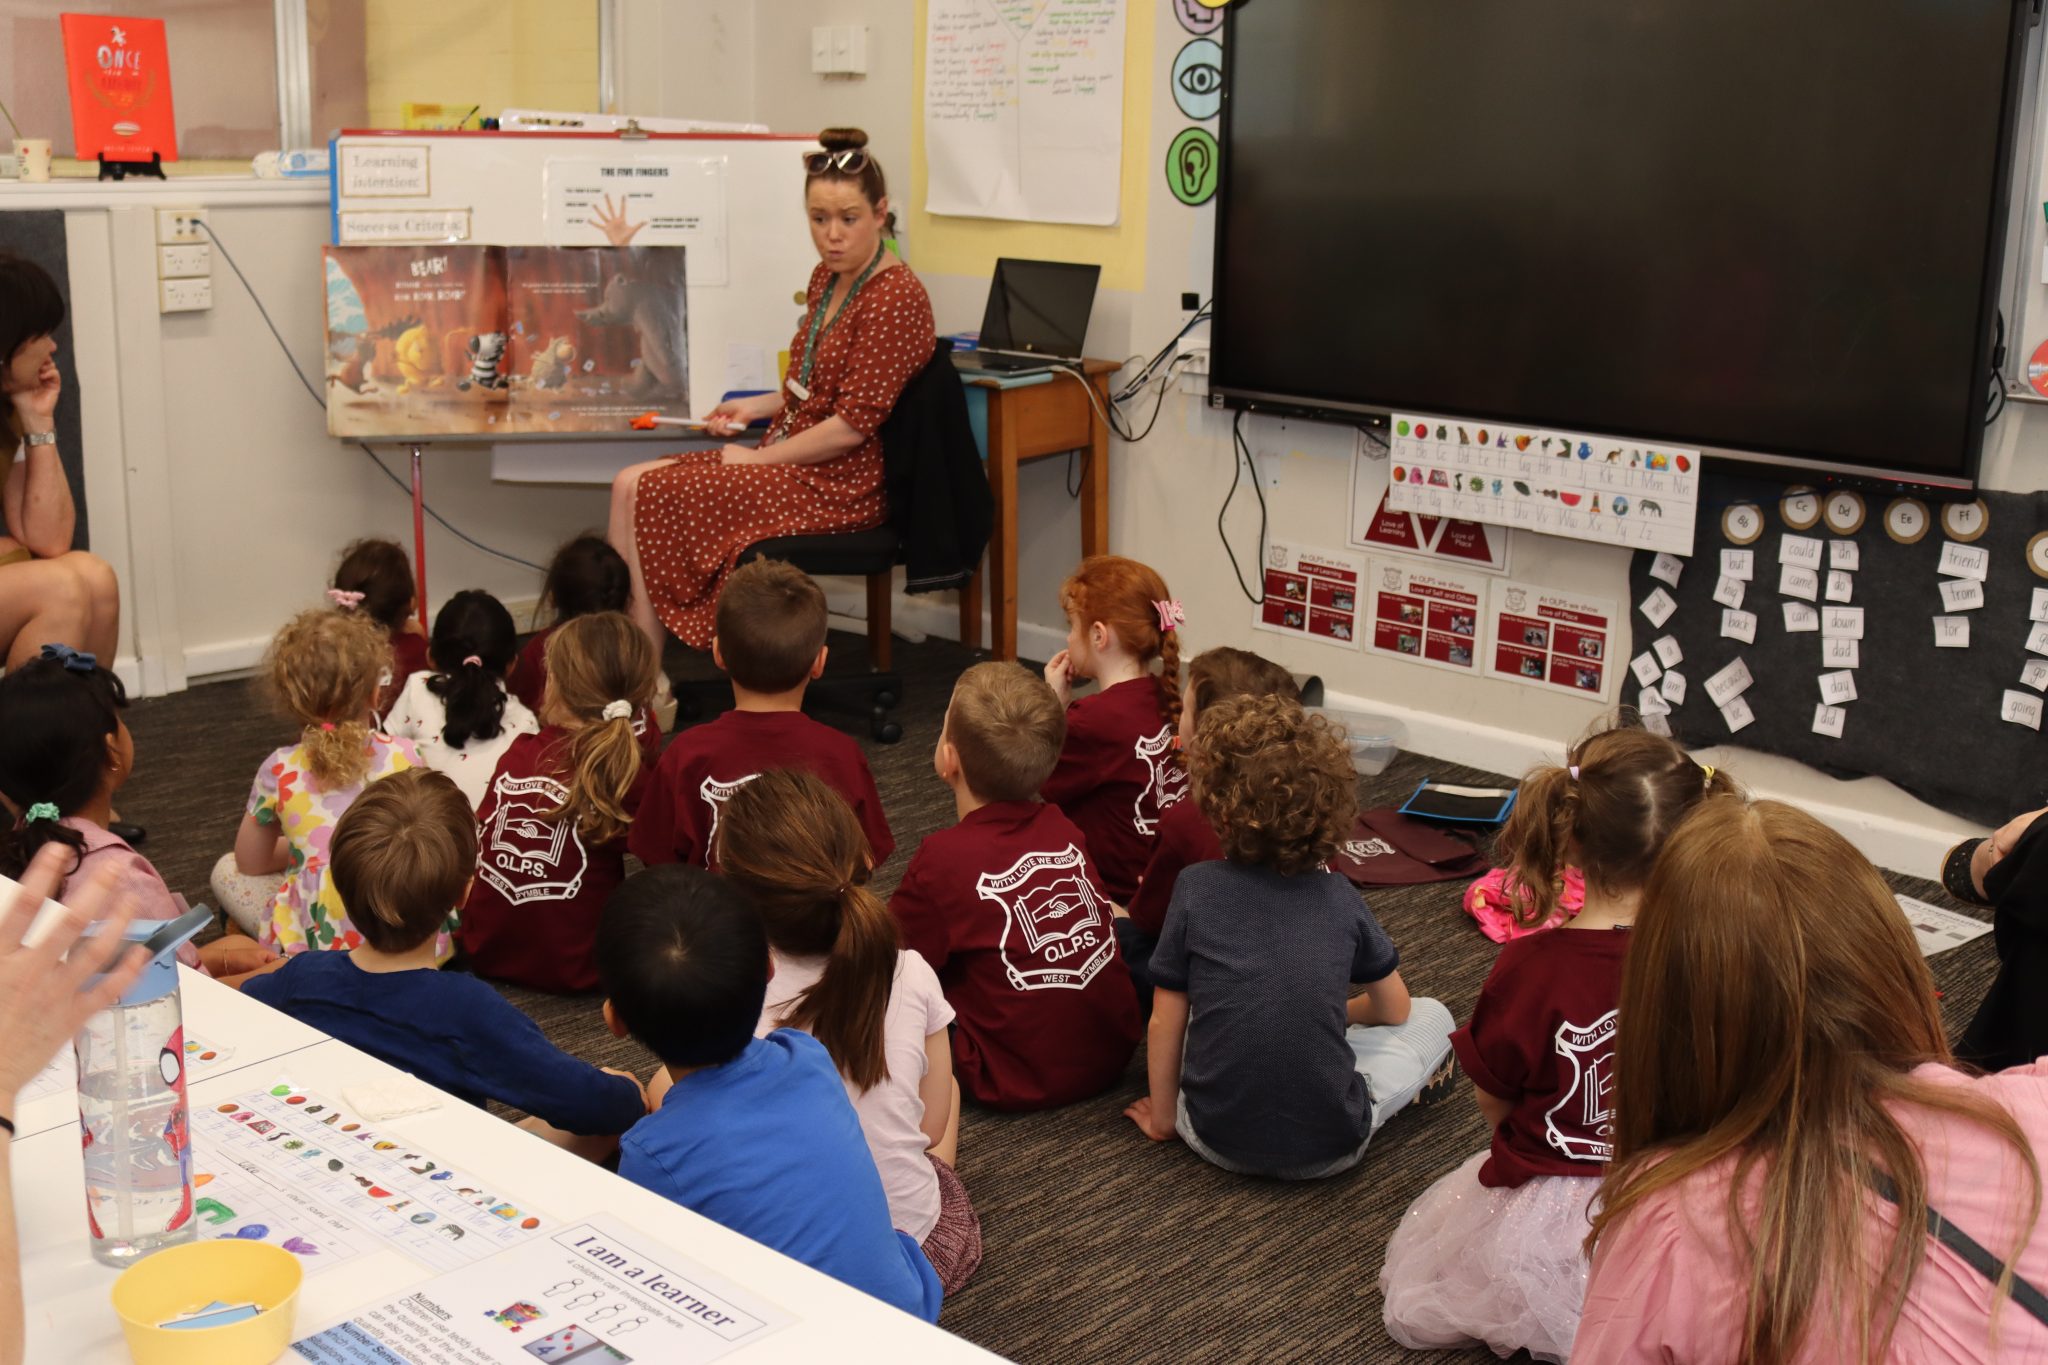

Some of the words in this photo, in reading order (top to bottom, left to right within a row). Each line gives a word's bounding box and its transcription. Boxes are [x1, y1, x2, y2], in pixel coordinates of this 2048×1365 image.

[97, 45, 142, 70] ONCE
[352, 155, 419, 169] Learning
[601, 168, 615, 177] THE
[617, 168, 634, 177] FIVE
[636, 168, 669, 177] FINGERS
[347, 220, 400, 232] Success
[1795, 500, 1808, 512] Cc
[1838, 504, 1851, 517] Dd
[1381, 519, 1397, 528] Love
[1397, 521, 1405, 530] of
[1737, 515, 1750, 528] Bb
[1900, 512, 1912, 525] Ee
[1958, 510, 1971, 522] Ff
[1379, 526, 1406, 538] Learning
[1788, 539, 1816, 559] could
[1949, 545, 1983, 569] friend
[1728, 551, 1745, 570] but
[1299, 564, 1313, 572] Love
[1319, 567, 1343, 579] Learning
[1788, 574, 1813, 590] came
[1410, 585, 1425, 594] Love
[1425, 587, 1432, 595] of
[1432, 588, 1443, 597] Self
[1444, 591, 1456, 600] and
[1456, 592, 1476, 604] Others
[1950, 583, 1977, 602] from
[1539, 607, 1553, 616] Love
[1553, 609, 1561, 618] of
[1561, 611, 1579, 621] Place
[1831, 609, 1856, 629] down
[1943, 617, 1960, 637] for
[1832, 639, 1851, 657] dad
[1831, 675, 1851, 699] day
[1821, 706, 1838, 727] did
[2010, 700, 2036, 724] going
[1144, 741, 1161, 752] WITH
[520, 781, 543, 790] LOVE
[711, 785, 734, 797] WITH
[495, 853, 548, 879] O.L.P.S.
[990, 874, 1017, 889] WITH
[1017, 856, 1038, 878] LOVE
[1036, 856, 1051, 865] WE
[1053, 852, 1076, 865] GROW
[488, 873, 510, 892] WEST
[514, 887, 550, 900] PYMBLE
[1044, 930, 1101, 963] O.L.P.S.
[1042, 974, 1071, 984] WEST
[1079, 950, 1109, 982] PYMBLE
[1572, 1030, 1598, 1046] WITH
[1598, 1018, 1617, 1036] LO
[572, 1261, 605, 1284] children
[603, 1280, 621, 1293] can
[619, 1289, 665, 1318] investigate
[574, 1236, 597, 1248] I
[586, 1246, 628, 1269] am
[624, 1266, 645, 1279] a
[642, 1273, 736, 1327] learner
[413, 1291, 453, 1320] Numbers
[338, 1321, 375, 1348] Number
[352, 1316, 386, 1340] quantity
[384, 1338, 400, 1349] of
[368, 1309, 387, 1323] can
[383, 1321, 404, 1335] also
[401, 1333, 419, 1345] roll
[415, 1340, 433, 1355] the
[383, 1303, 399, 1316] the
[396, 1315, 431, 1342] quantity
[428, 1335, 443, 1345] of
[438, 1340, 454, 1354] the
[398, 1297, 434, 1323] Children
[431, 1321, 450, 1334] use
[447, 1331, 473, 1350] teddy
[471, 1346, 495, 1363] bear
[322, 1329, 352, 1348] which
[291, 1341, 321, 1361] tactile
